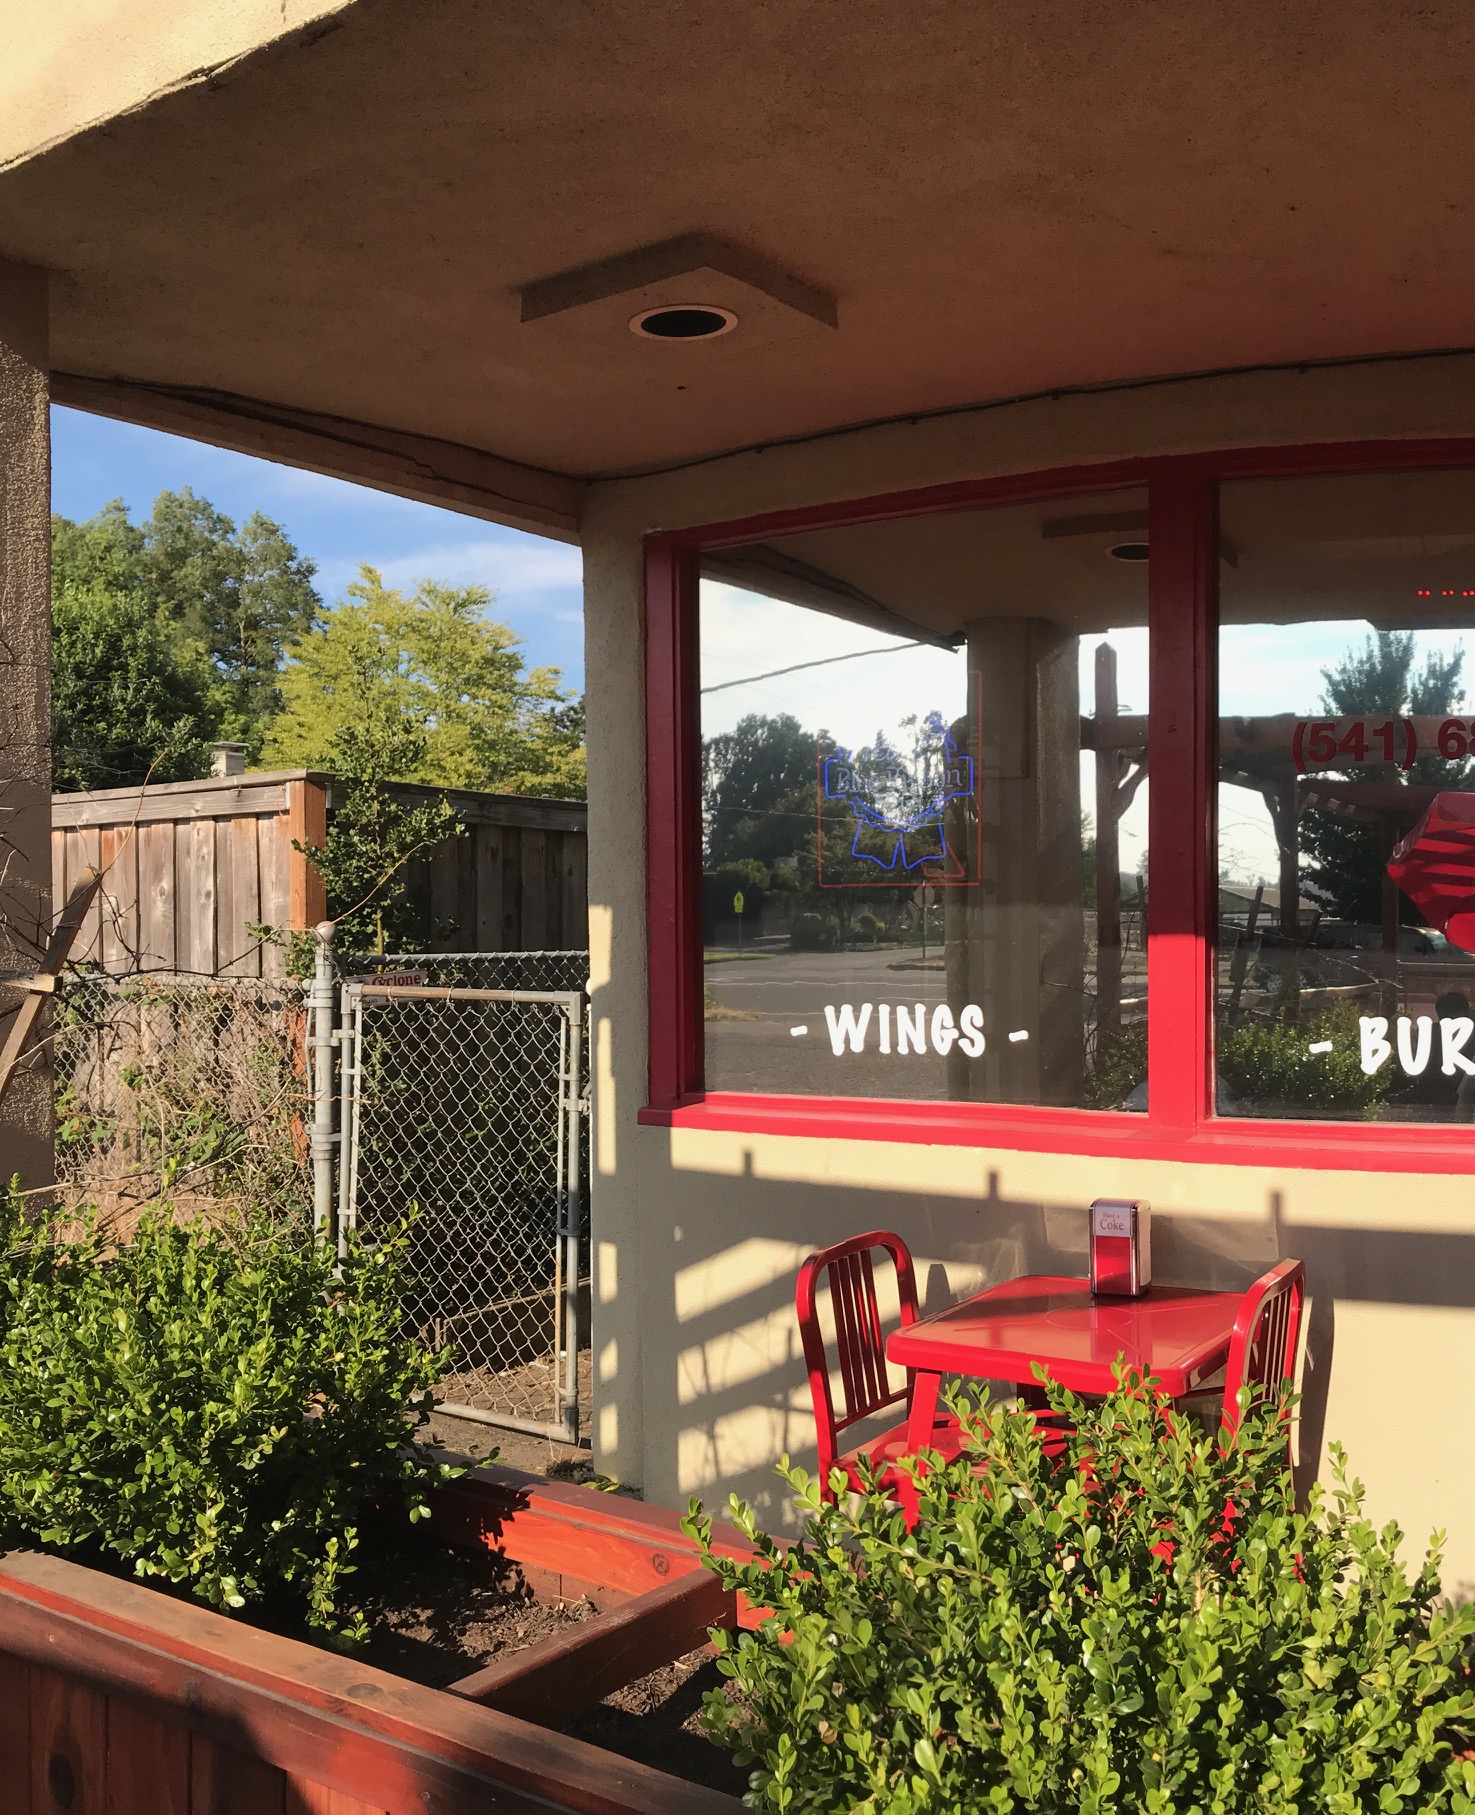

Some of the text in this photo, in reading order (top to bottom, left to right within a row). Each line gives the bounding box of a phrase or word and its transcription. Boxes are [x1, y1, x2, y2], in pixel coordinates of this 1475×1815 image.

[1292, 718, 1418, 772] (541)
[371, 974, 421, 987] Cyclone
[824, 1002, 986, 1057] WINGS
[1100, 1218, 1125, 1231] Coke
